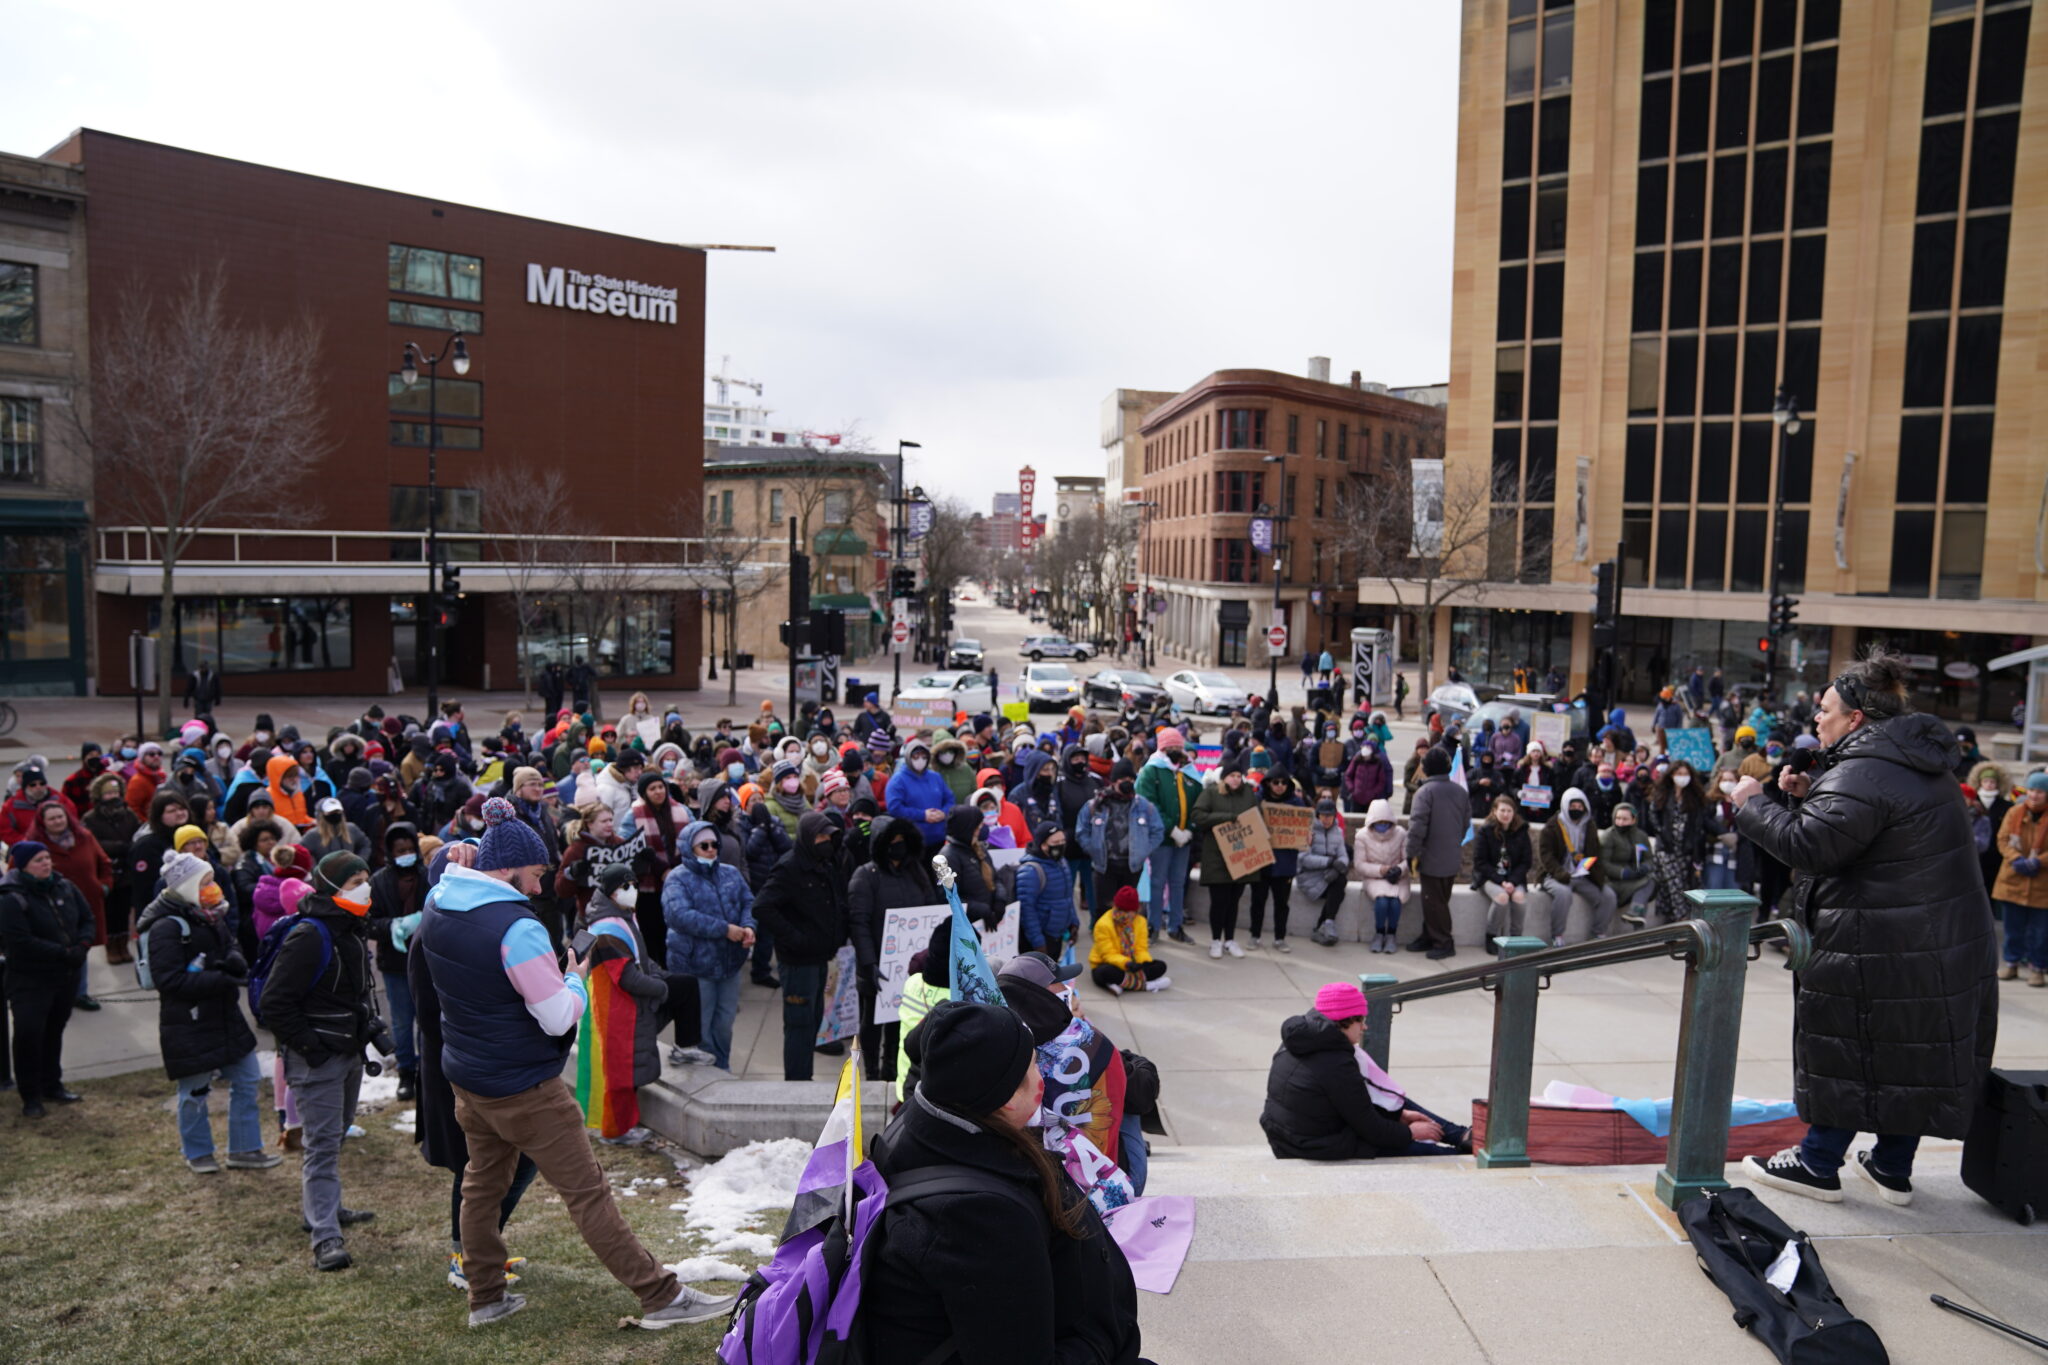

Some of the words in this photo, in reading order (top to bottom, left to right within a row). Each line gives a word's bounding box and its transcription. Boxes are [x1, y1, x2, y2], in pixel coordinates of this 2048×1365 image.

[527, 263, 678, 324] Museum
[567, 269, 592, 286] The
[593, 273, 625, 291] State
[625, 279, 678, 300] Historical
[1252, 519, 1265, 546] 100
[886, 913, 946, 934] PROTE
[884, 935, 928, 955] BLAC
